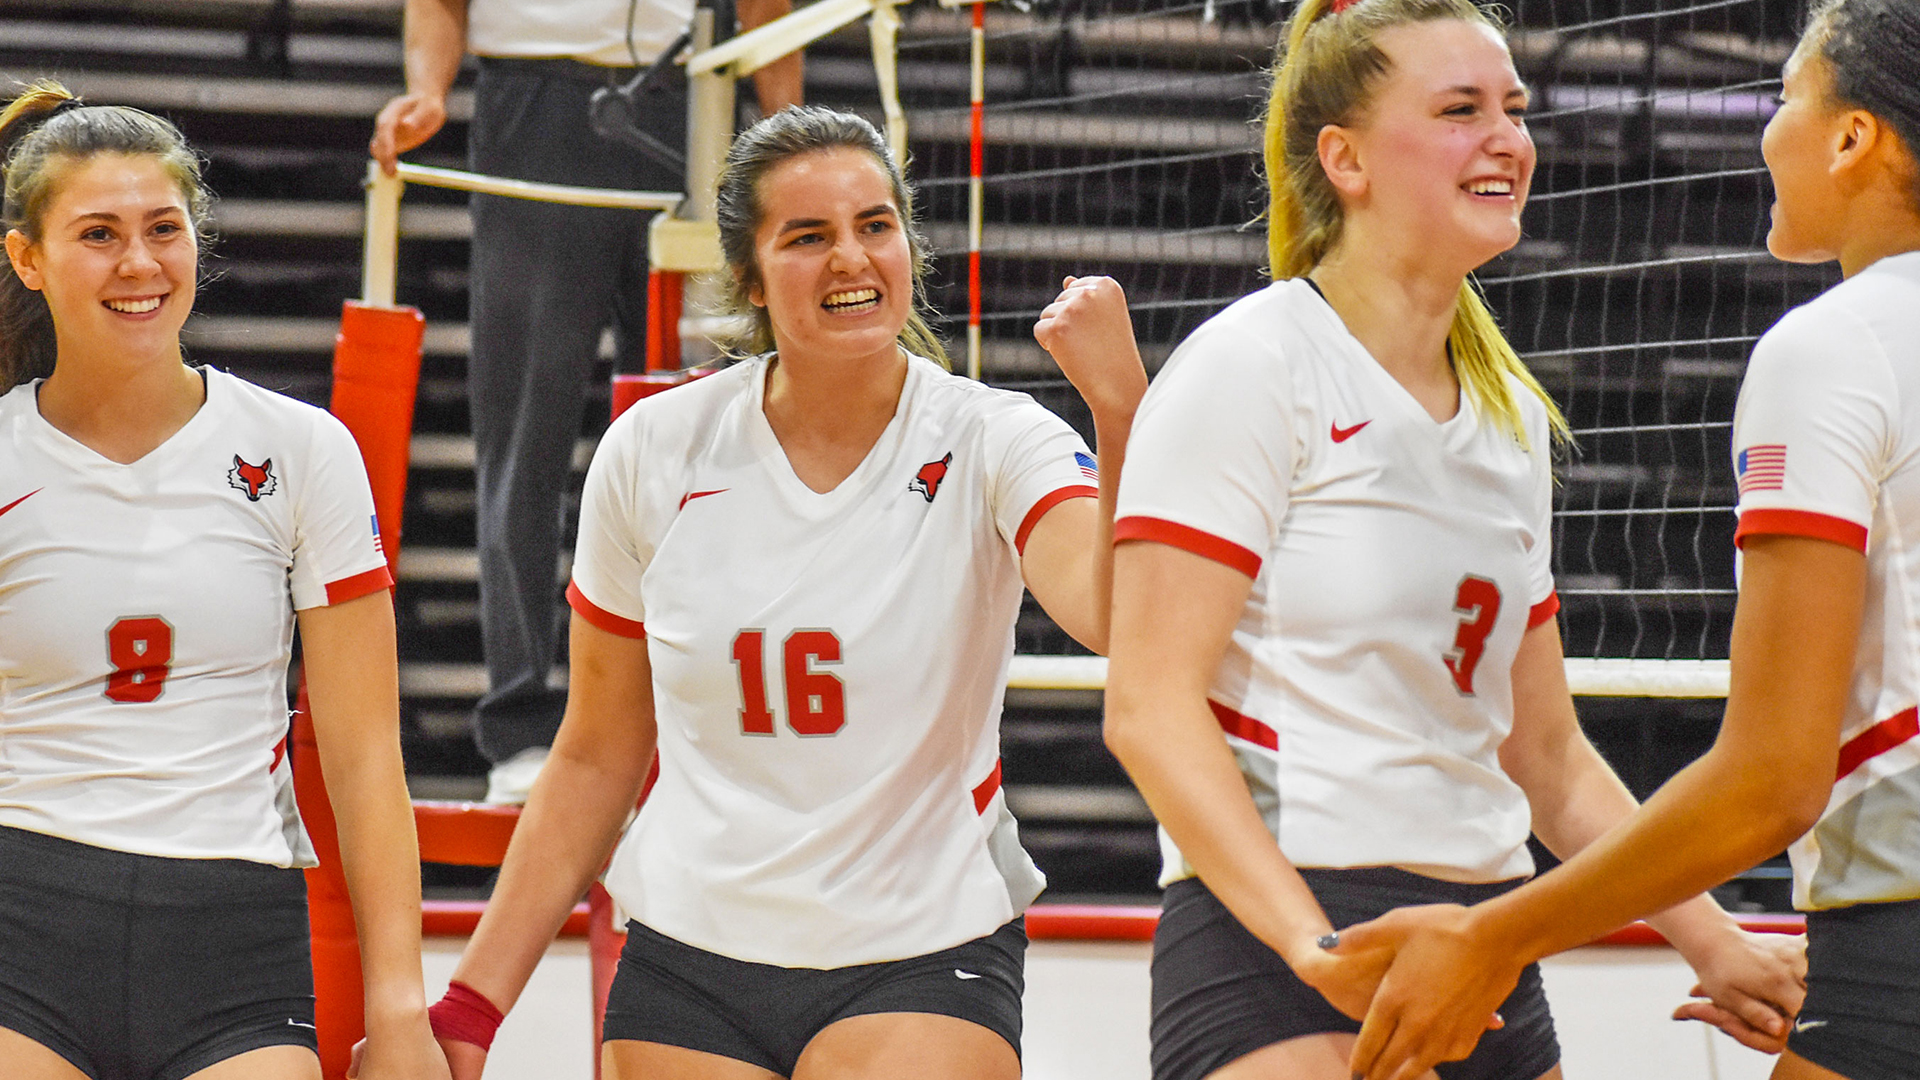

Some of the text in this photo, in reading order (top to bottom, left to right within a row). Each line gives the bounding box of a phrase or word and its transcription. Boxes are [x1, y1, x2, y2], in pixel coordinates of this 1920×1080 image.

[102, 614, 175, 704] 8
[730, 627, 848, 738] 16
[1442, 572, 1503, 698] 3
